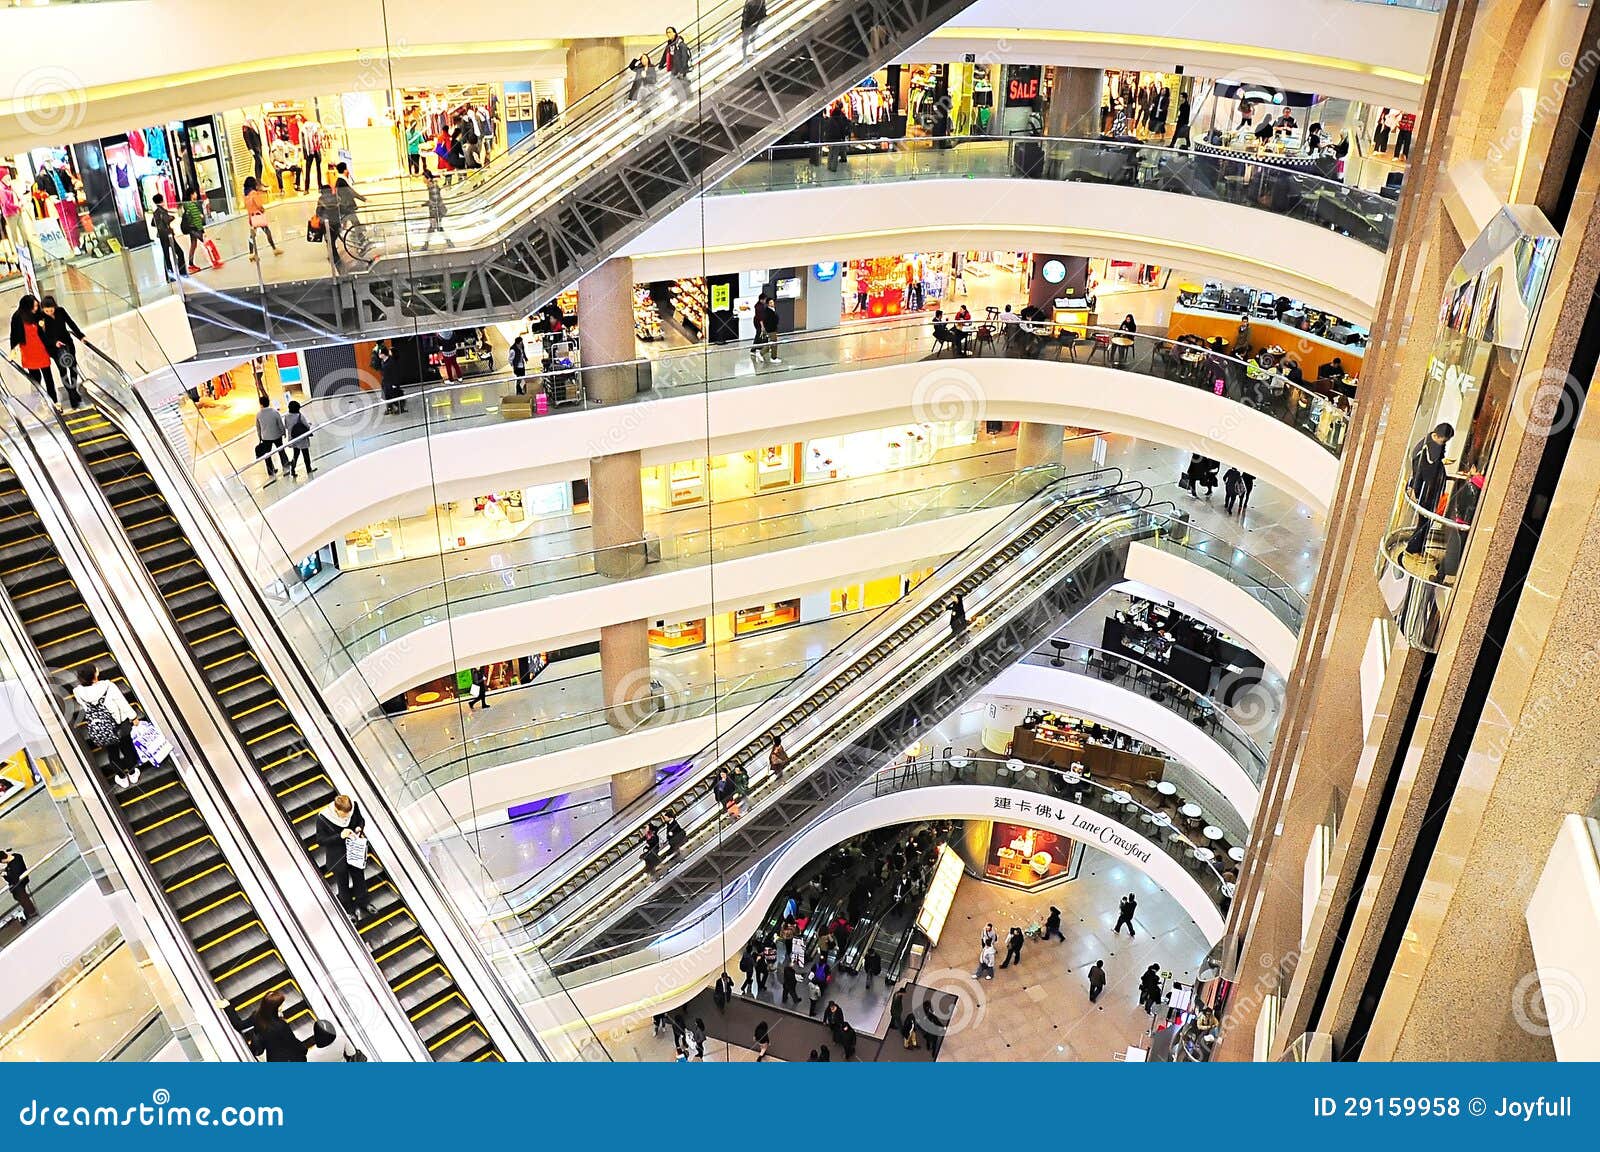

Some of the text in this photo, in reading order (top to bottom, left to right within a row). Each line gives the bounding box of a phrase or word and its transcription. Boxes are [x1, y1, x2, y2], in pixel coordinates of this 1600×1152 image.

[1009, 79, 1039, 101] SALE
[993, 795, 1153, 864] 連卡佛 Lane Crawford
